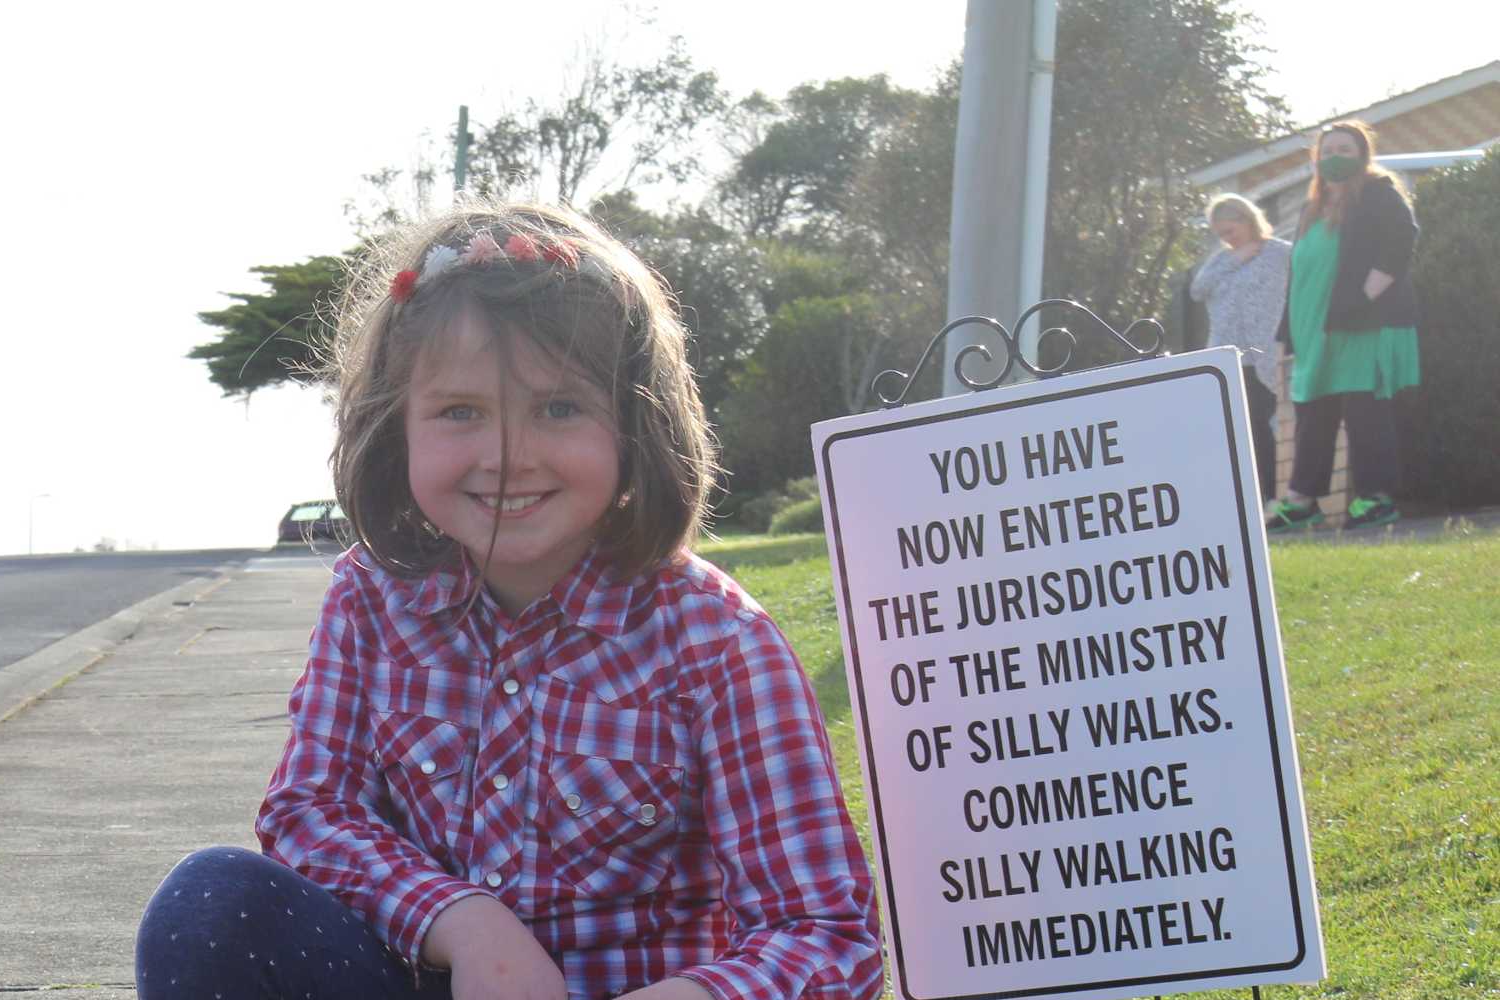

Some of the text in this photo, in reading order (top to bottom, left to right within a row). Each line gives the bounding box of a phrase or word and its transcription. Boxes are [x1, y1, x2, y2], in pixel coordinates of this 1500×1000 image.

[929, 420, 1124, 494] YOU HAVE
[897, 483, 1180, 570] NOW ENTERED
[868, 544, 1230, 641] THE JURISDICTION
[890, 615, 1228, 707] OF THE MINISTRY
[906, 688, 1233, 773] OF SILLY WALKS.
[963, 762, 1193, 833] COMMENCE
[939, 826, 1237, 903] SILLY WALKING
[962, 897, 1232, 968] IMMEDIATELY.
